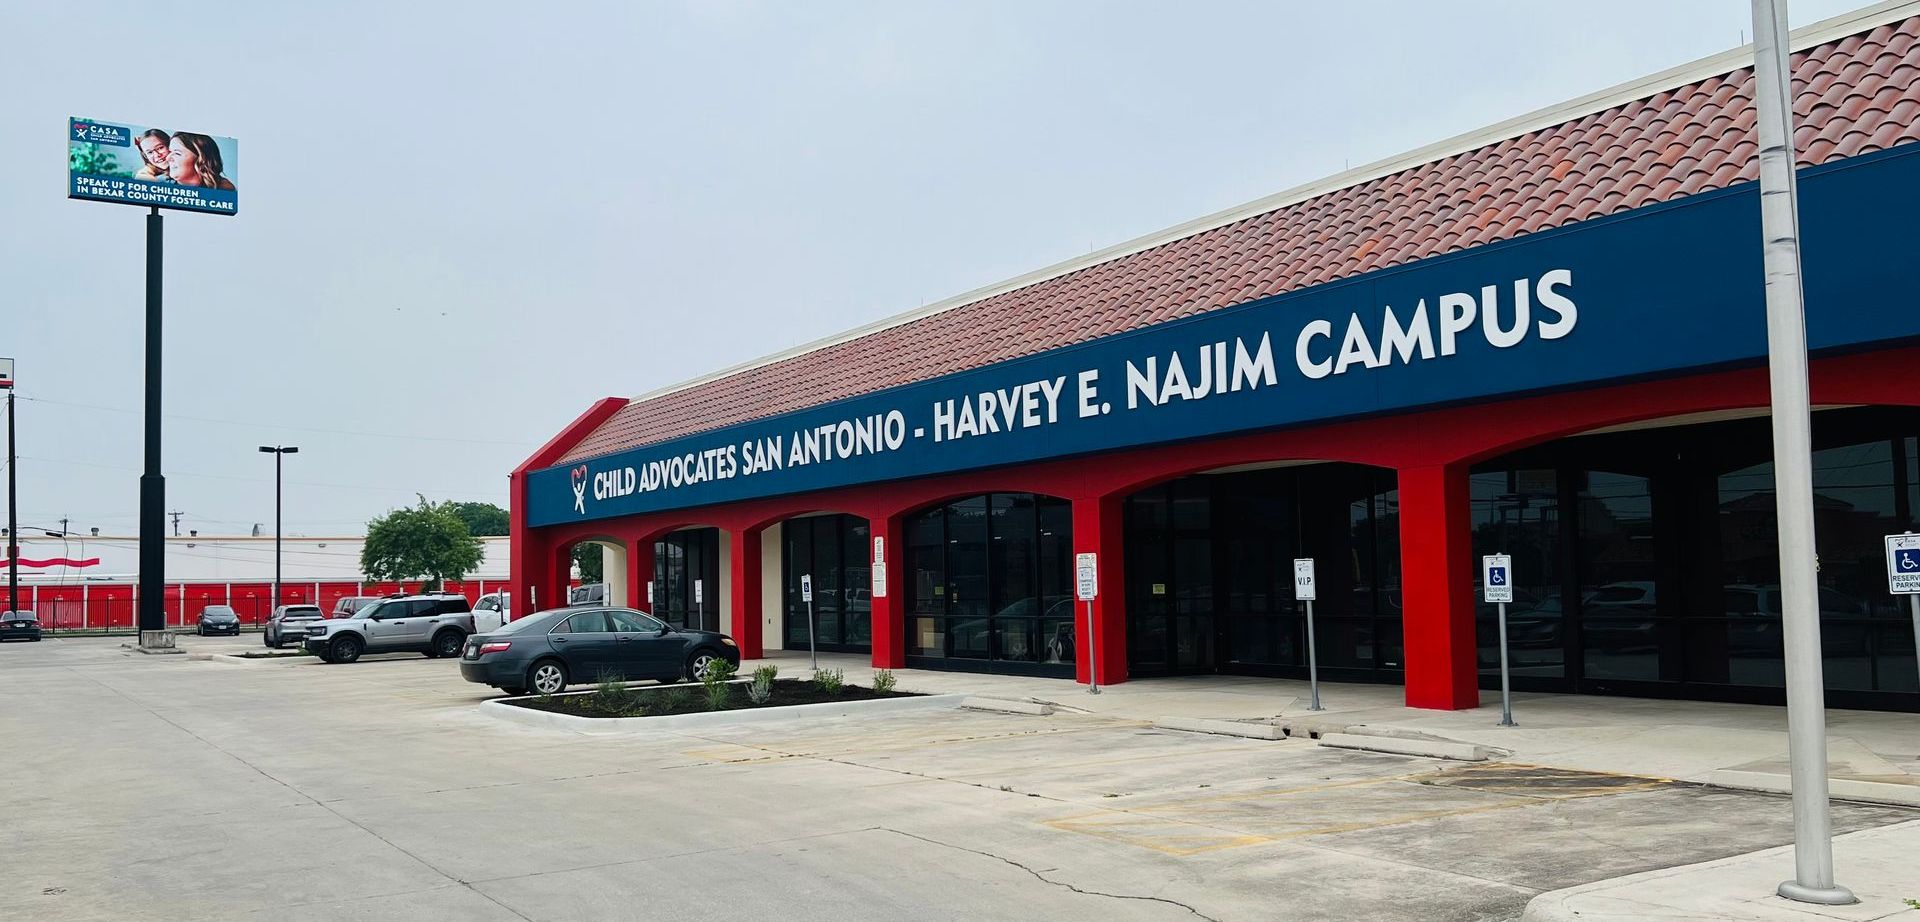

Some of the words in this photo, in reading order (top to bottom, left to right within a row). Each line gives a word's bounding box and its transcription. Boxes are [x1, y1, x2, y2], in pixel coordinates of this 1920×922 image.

[90, 125, 119, 136] CASA
[77, 177, 109, 188] SPEAK
[111, 180, 125, 189] UP
[127, 183, 148, 192] FOR
[150, 185, 199, 198] CHILDREN
[77, 185, 89, 193] IN
[91, 187, 124, 198] BEXAR
[127, 190, 168, 203] COUNTY
[170, 196, 207, 208] FOSTER
[209, 200, 234, 210] CARE
[593, 465, 636, 501] CHILD
[639, 444, 737, 494] ADVOCATES
[742, 435, 783, 476] SAN
[788, 409, 906, 469] ANTONIO
[914, 427, 925, 438] -
[933, 375, 1068, 443] HARVEY
[1078, 368, 1112, 419] E.
[1126, 330, 1278, 410] NAJIM
[1295, 268, 1579, 380] CAMPUS
